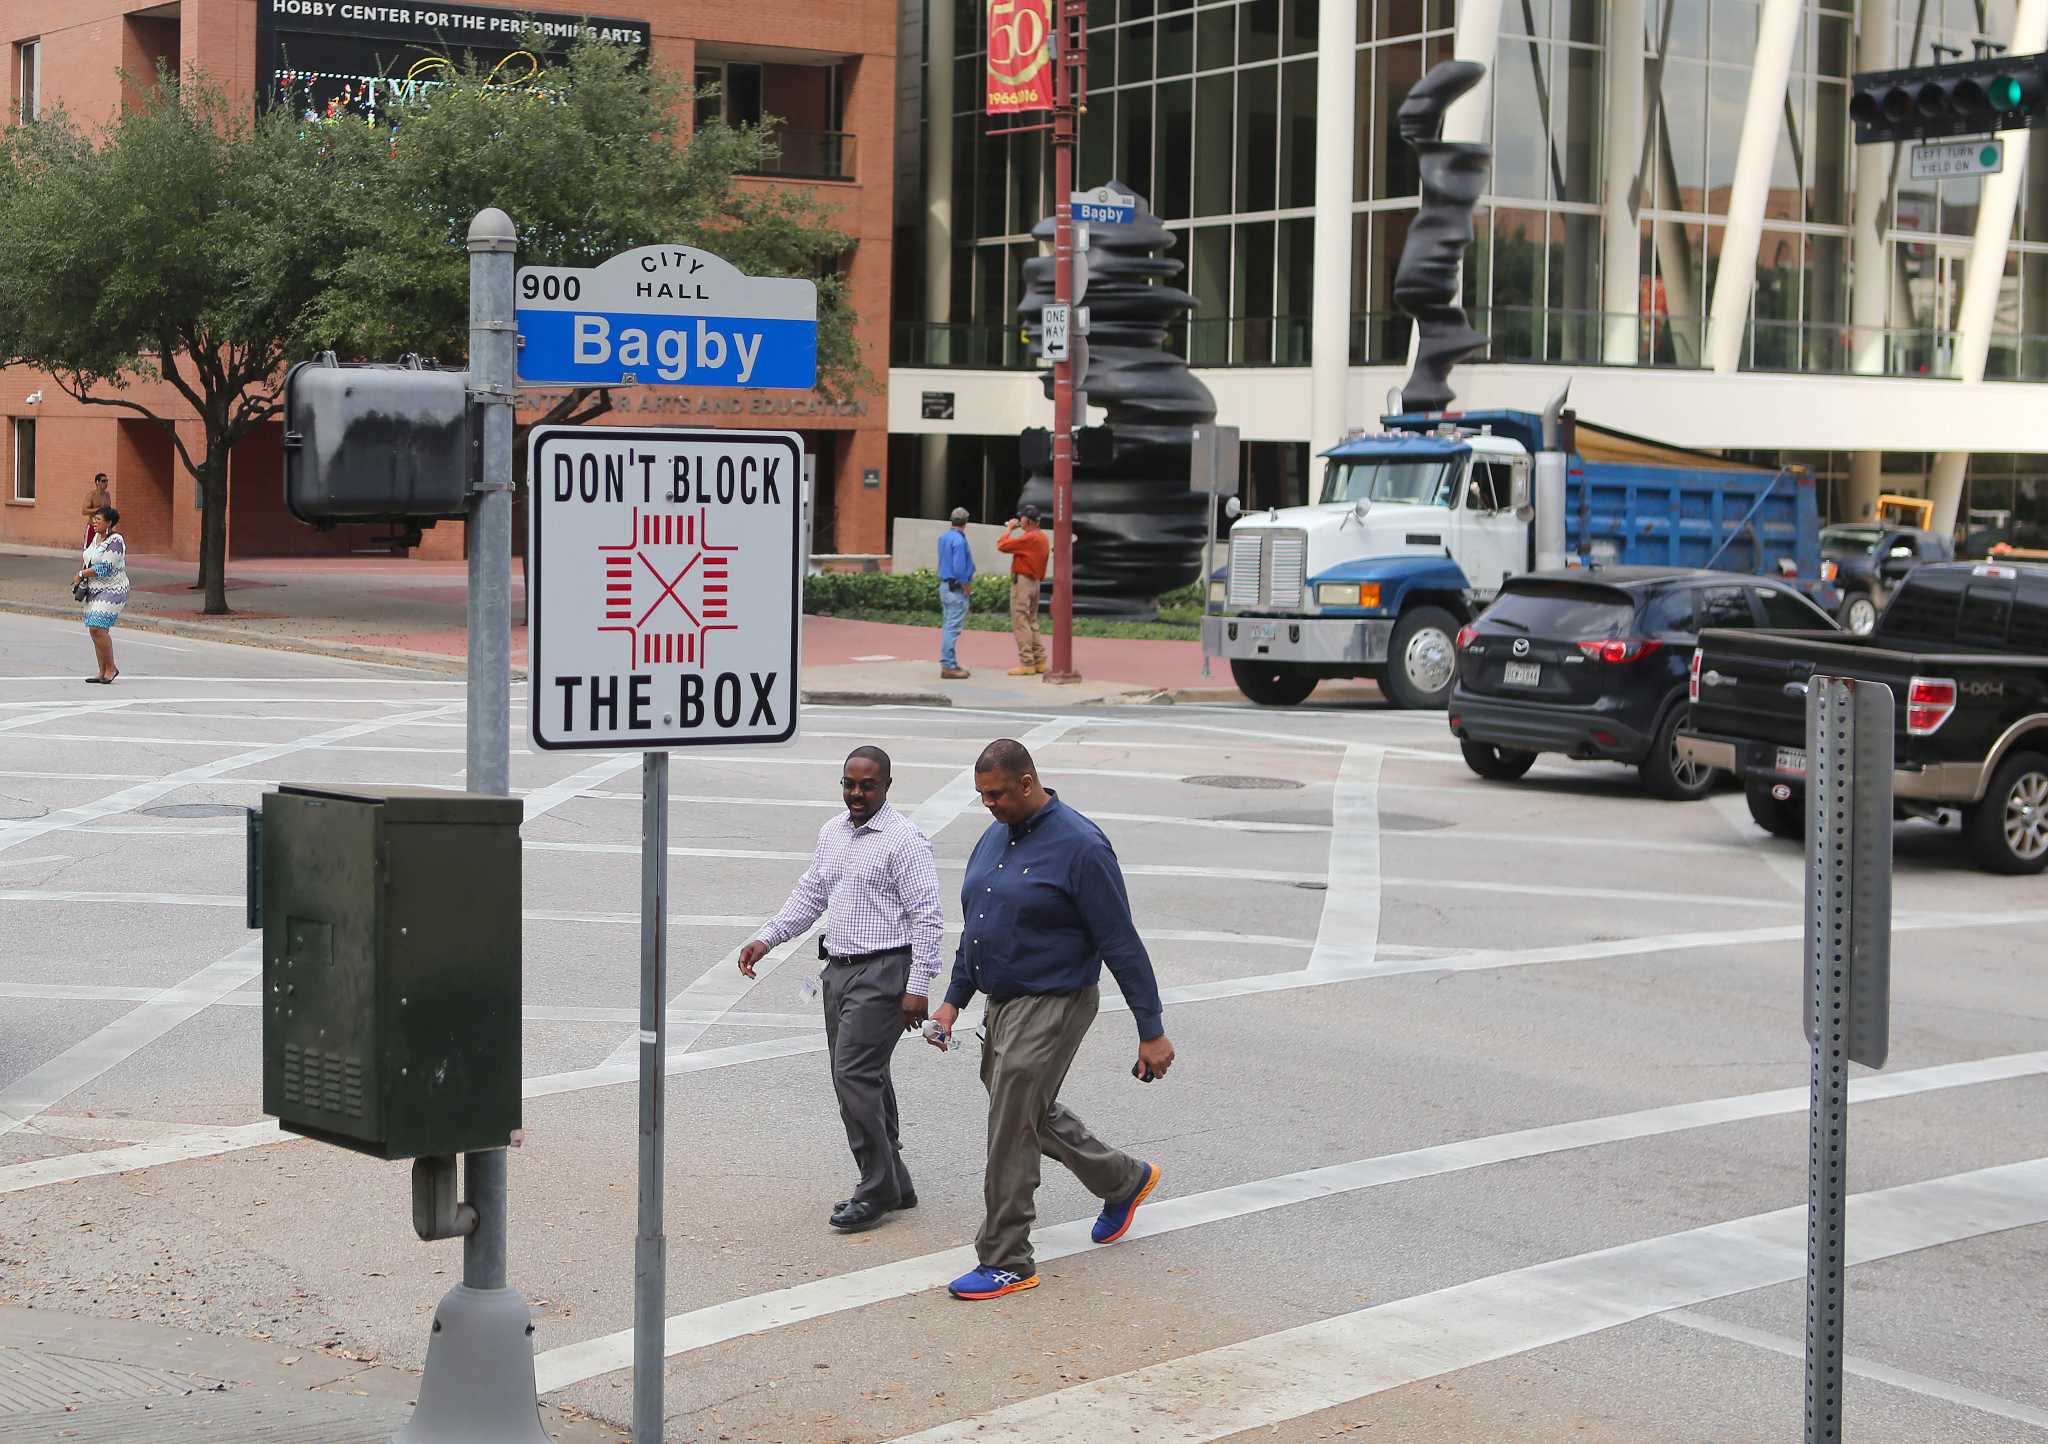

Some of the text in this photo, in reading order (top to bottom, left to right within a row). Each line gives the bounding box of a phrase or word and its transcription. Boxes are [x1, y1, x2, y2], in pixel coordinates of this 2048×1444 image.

[272, 0, 336, 17] HOBBY
[340, 4, 411, 24] CENTER
[414, 11, 449, 27] FOR
[451, 14, 486, 30] THE
[600, 28, 642, 43] ARTS
[991, 0, 1043, 64] 50
[1917, 147, 1941, 160] LEFT
[1955, 159, 1970, 170] ON
[1081, 205, 1123, 223] Bagby
[641, 251, 704, 275] CITY
[522, 274, 581, 301] 900
[636, 282, 709, 300] HALL
[1046, 310, 1065, 322] ONE
[1046, 325, 1065, 337] WAY
[574, 314, 763, 383] Bagby
[637, 393, 689, 414] ARTS
[697, 395, 743, 415] AND
[554, 447, 781, 505] DON'T BLOCK
[555, 671, 778, 732] THE BOX
